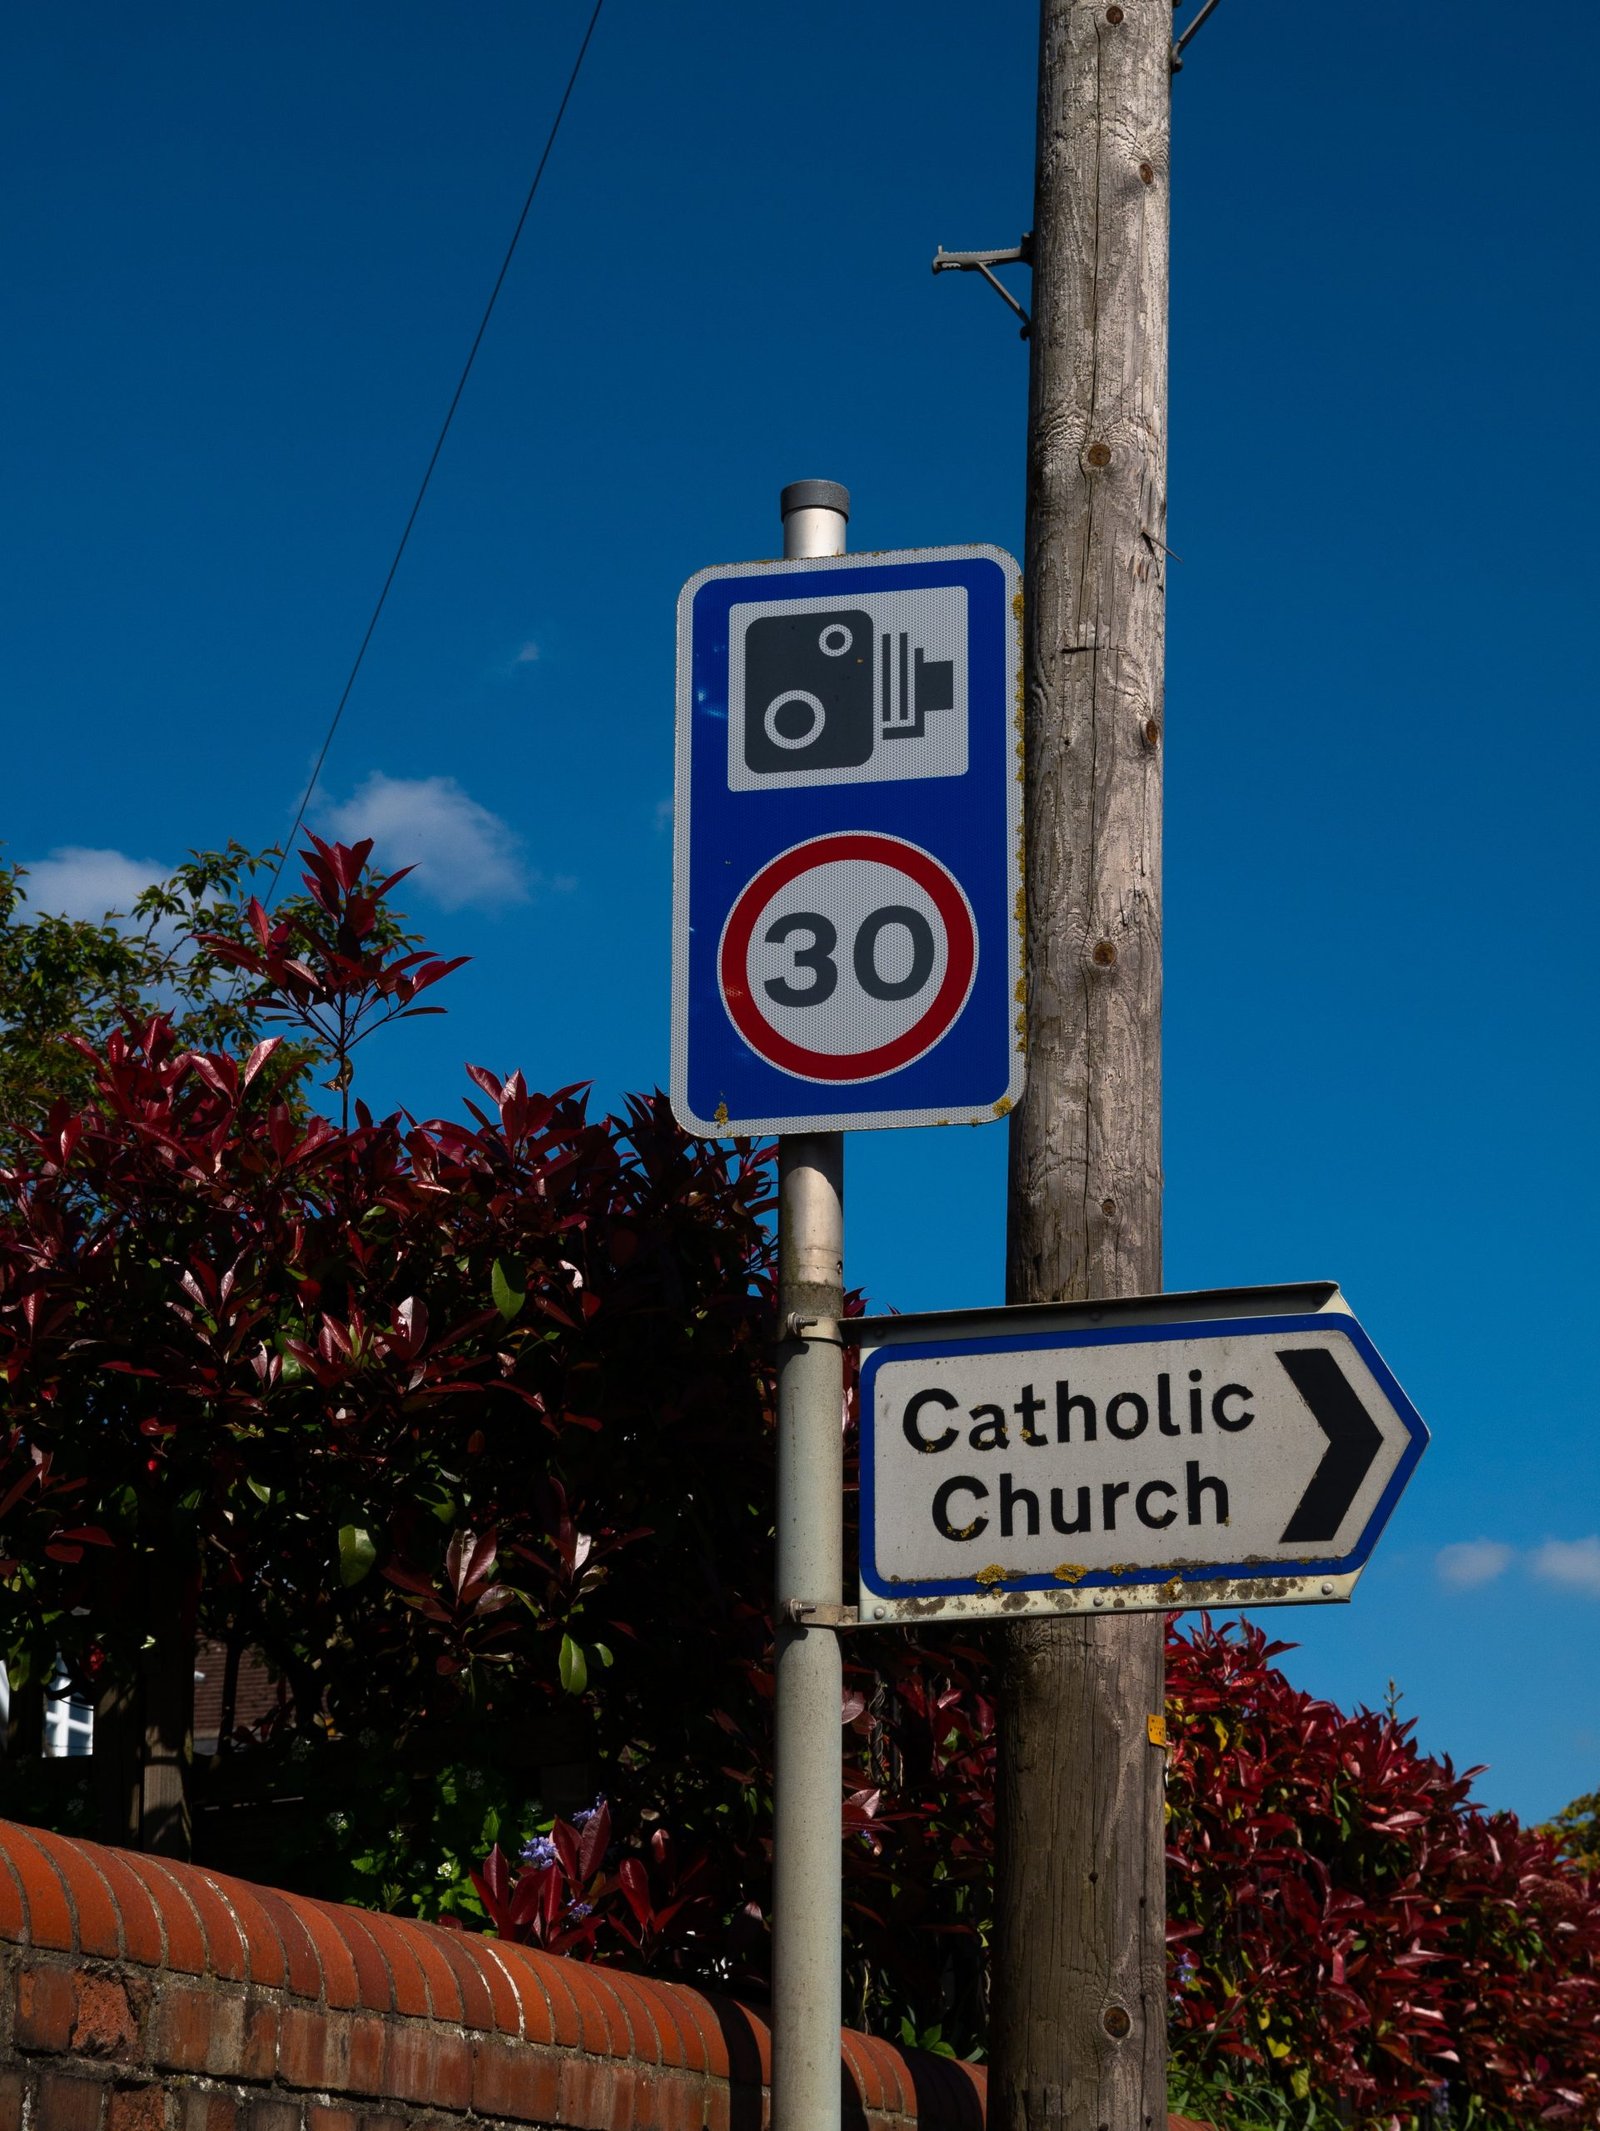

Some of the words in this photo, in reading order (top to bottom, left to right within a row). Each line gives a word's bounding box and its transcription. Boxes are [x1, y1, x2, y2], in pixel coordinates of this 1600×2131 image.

[764, 905, 934, 1007] 30
[902, 1368, 1255, 1453] Catholic
[932, 1460, 1229, 1541] Church
